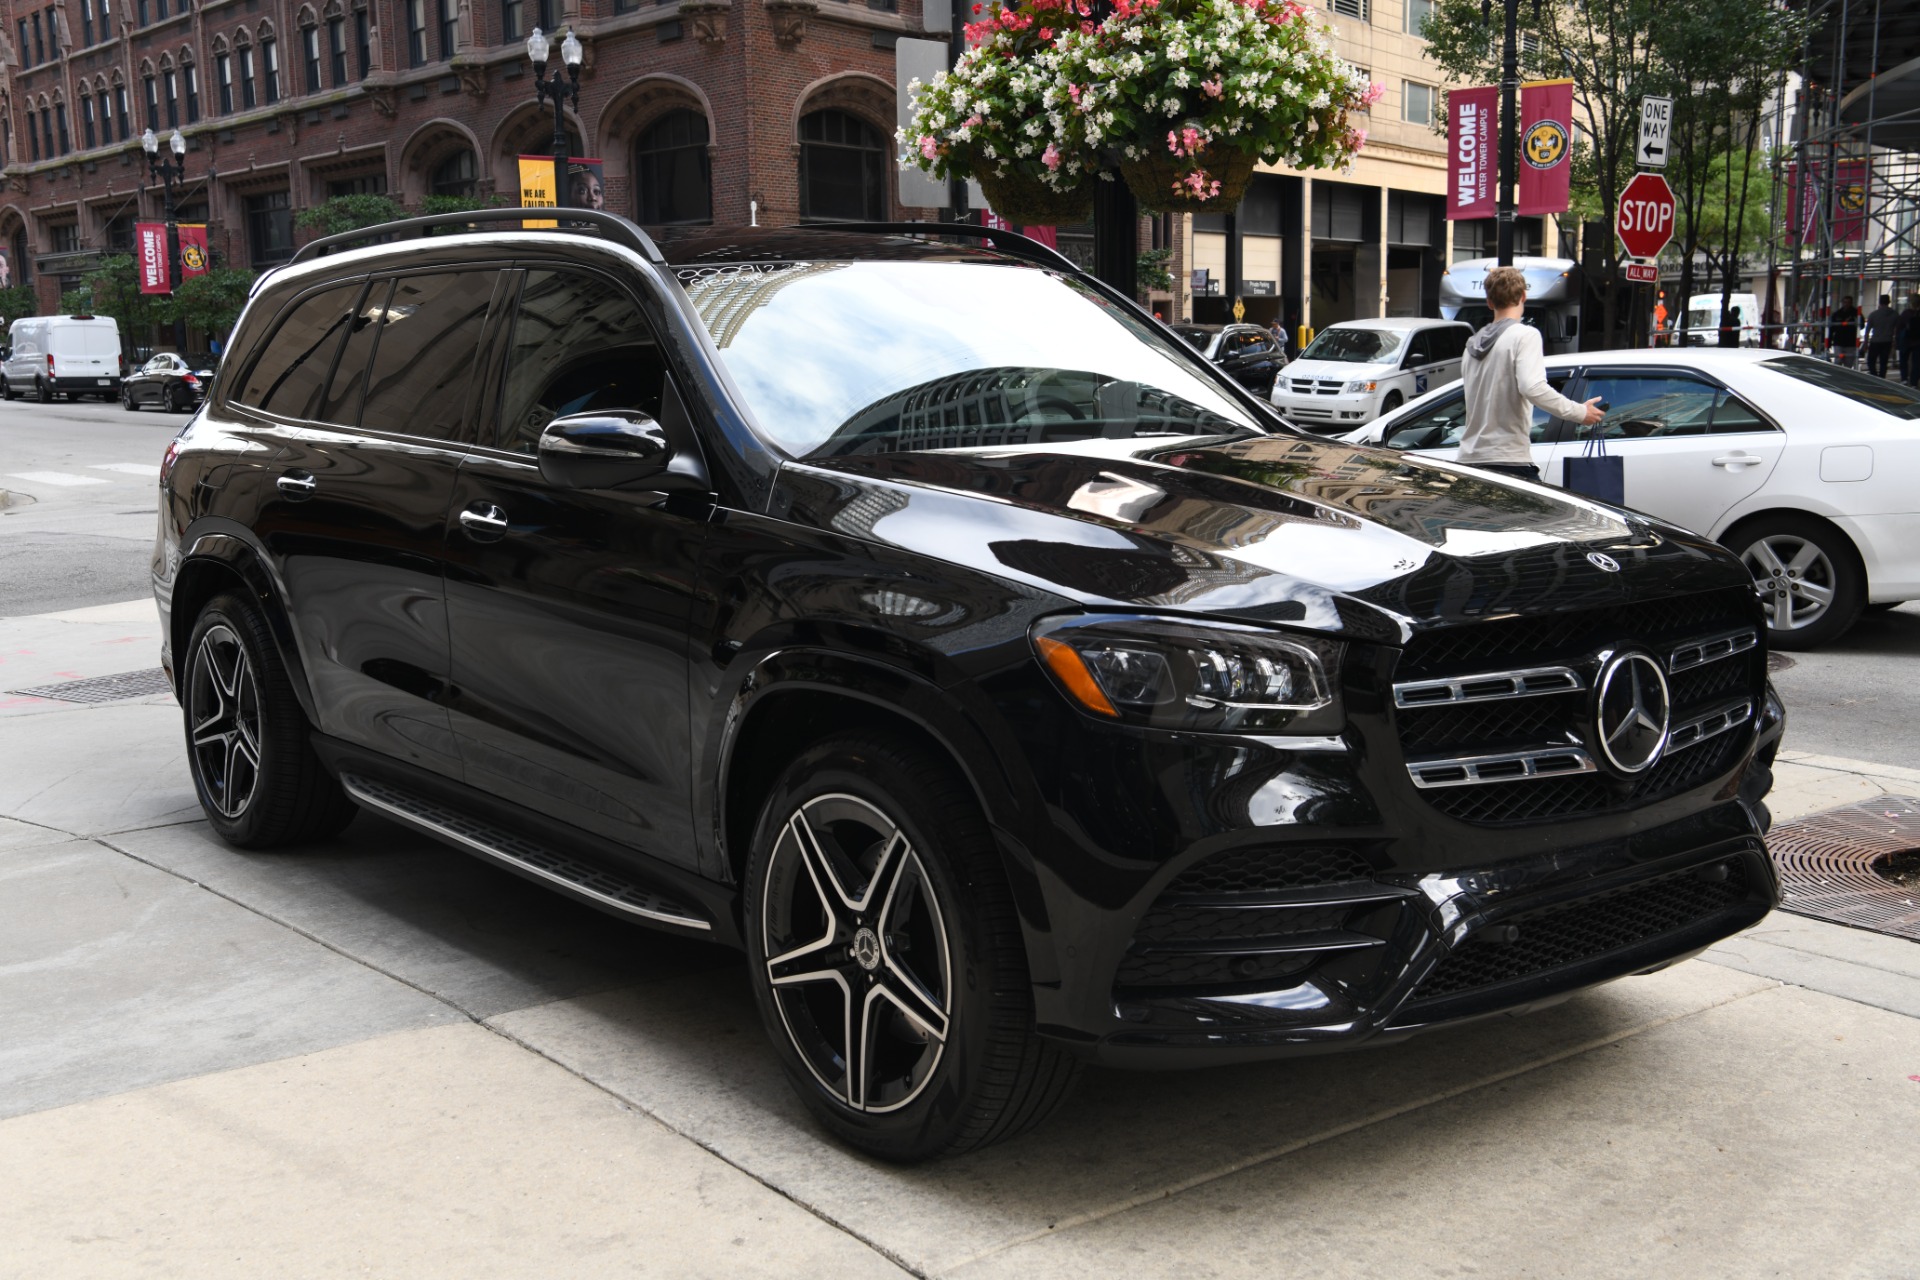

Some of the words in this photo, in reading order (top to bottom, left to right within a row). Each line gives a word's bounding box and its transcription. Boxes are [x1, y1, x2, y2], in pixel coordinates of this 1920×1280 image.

[1479, 108, 1488, 141] CAMPUS
[1645, 103, 1668, 121] ONE
[1643, 122, 1667, 139] WAY
[1458, 103, 1476, 207] WELCOME
[1479, 143, 1487, 171] TOWER
[524, 189, 533, 198] WE
[534, 189, 545, 198] ARE
[1479, 172, 1487, 199] WATER
[1621, 200, 1672, 233] STOP
[143, 231, 158, 286] WELCOME
[689, 272, 768, 287] George
[1629, 266, 1641, 278] ALL
[1642, 268, 1655, 279] WAY
